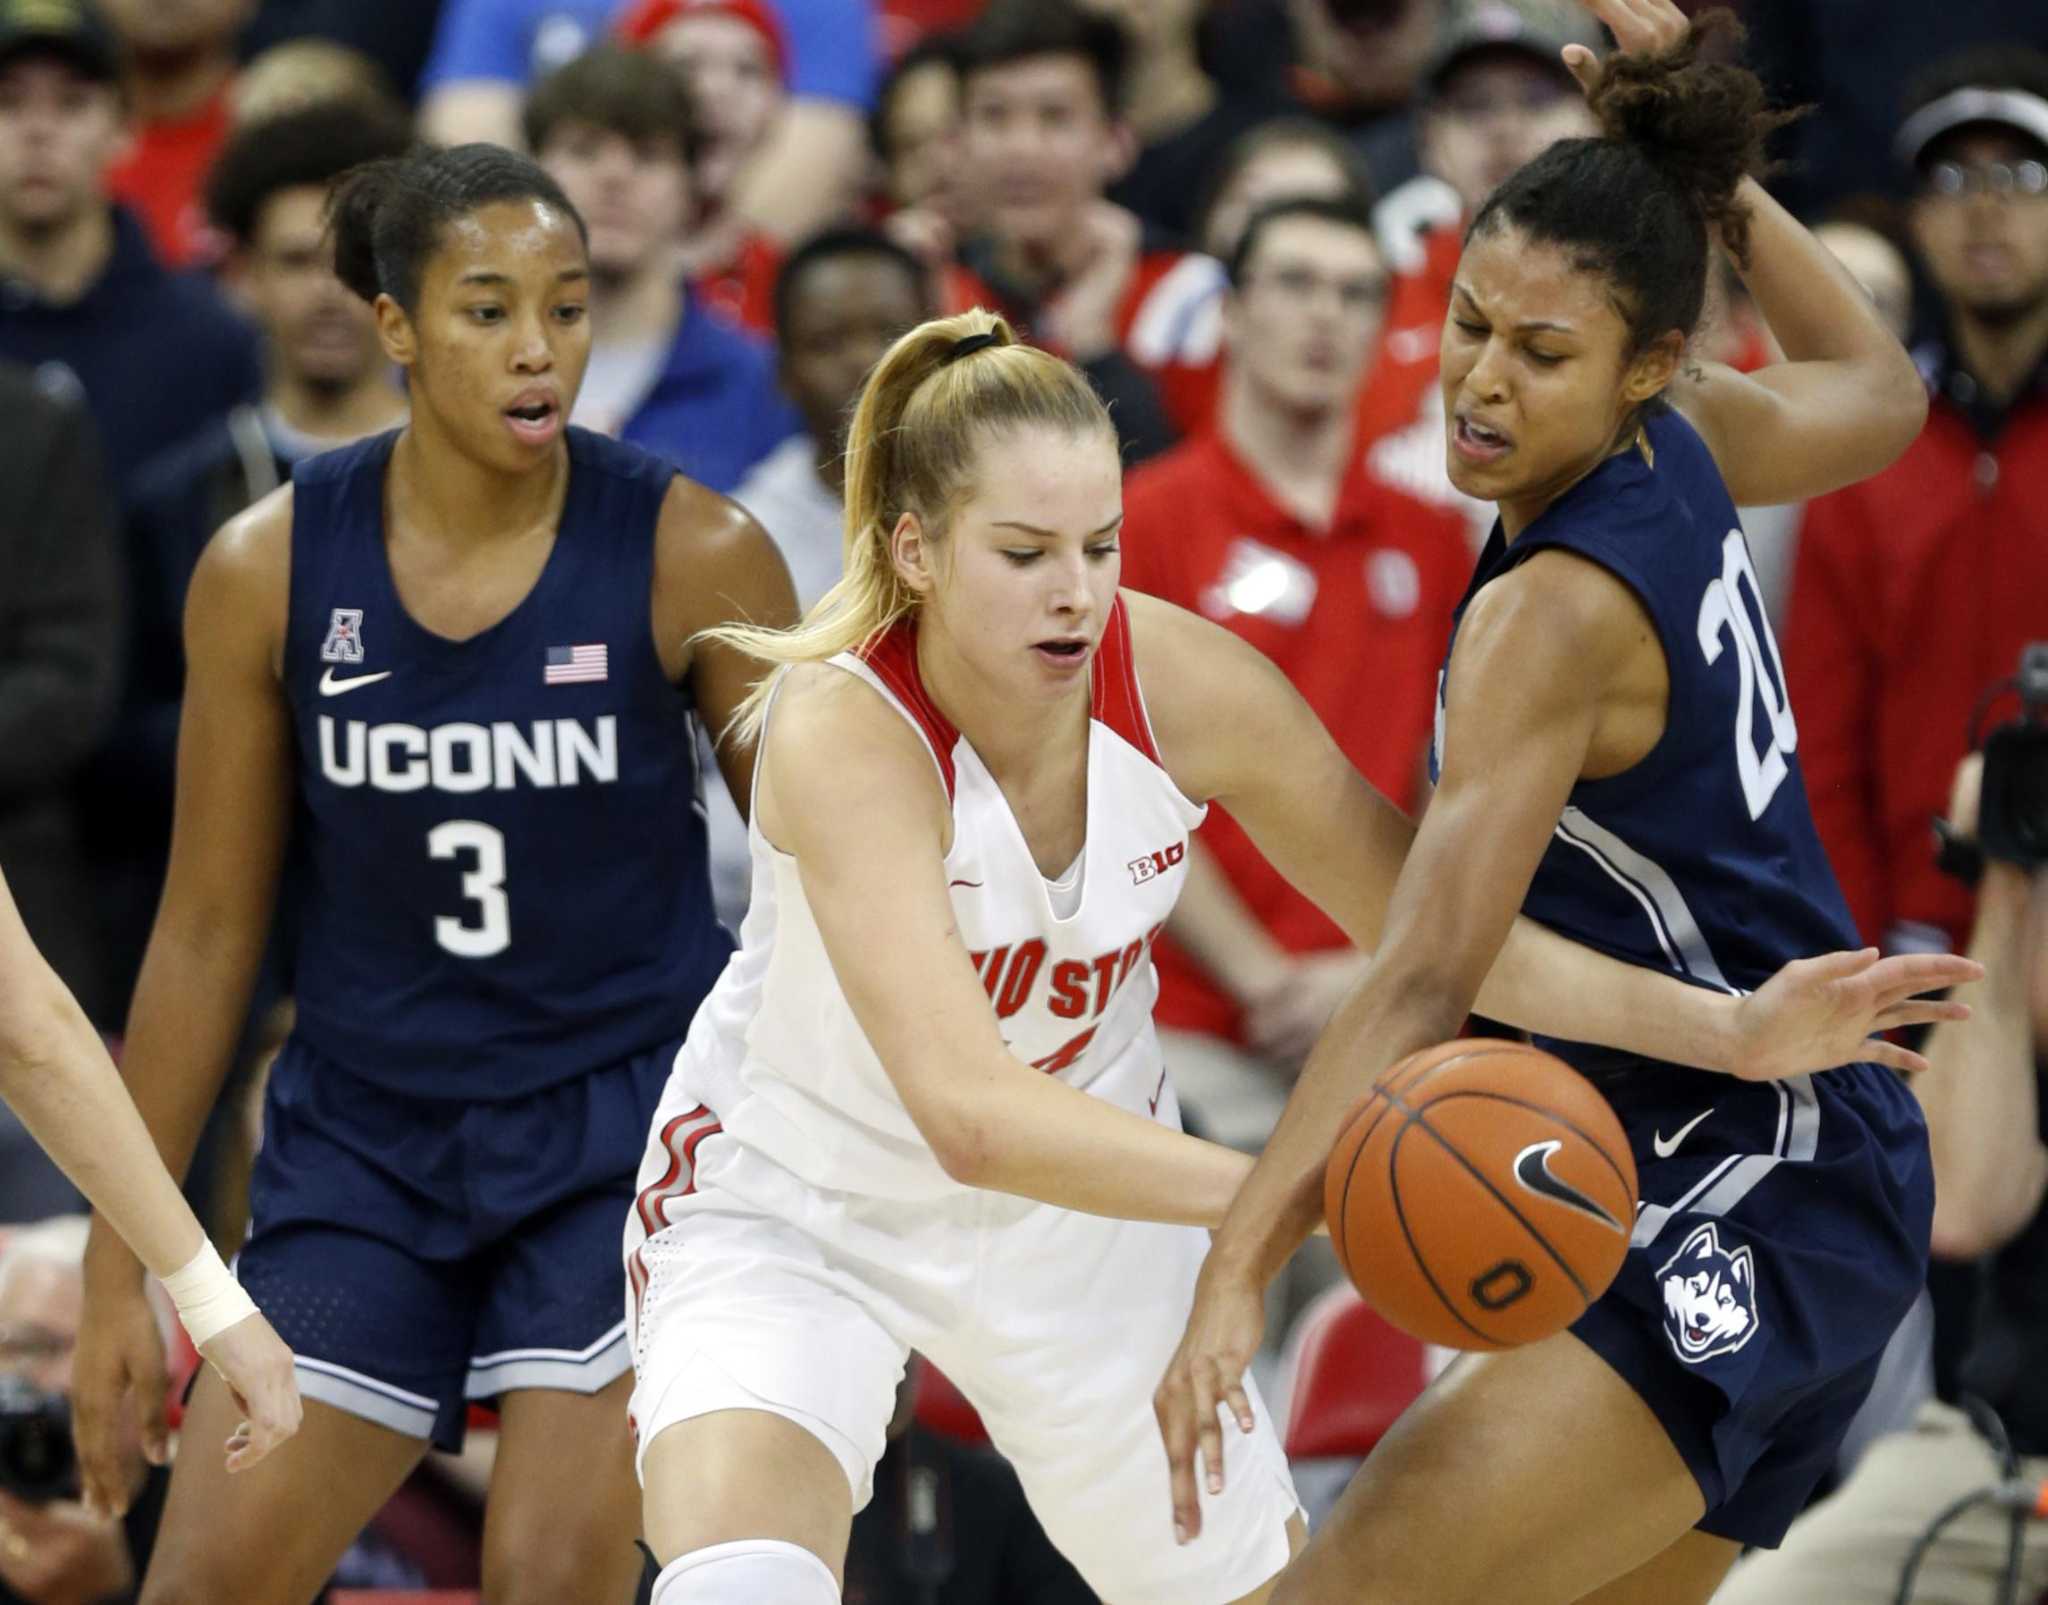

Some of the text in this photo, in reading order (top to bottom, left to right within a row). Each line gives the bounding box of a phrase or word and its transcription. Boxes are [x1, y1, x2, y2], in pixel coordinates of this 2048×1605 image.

[1697, 527, 1798, 821] 20
[318, 714, 618, 792] UCONN
[427, 819, 511, 958] 3
